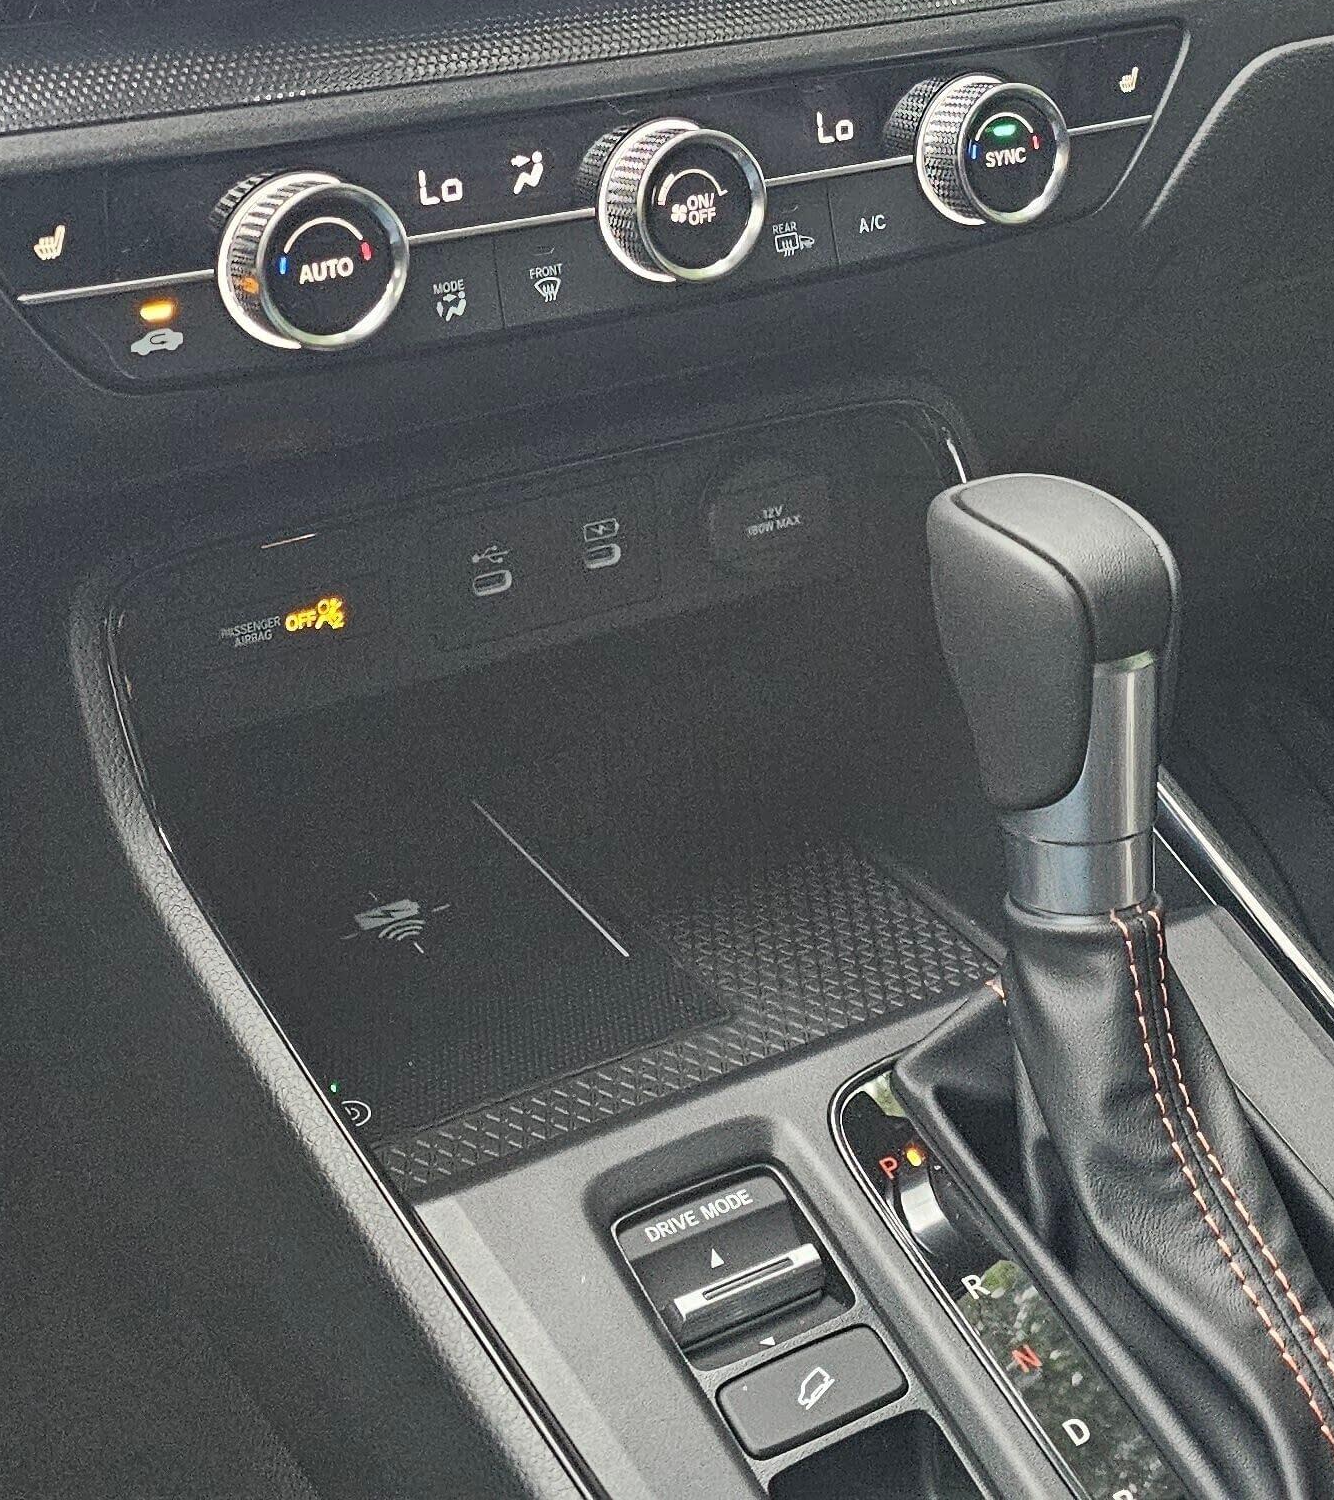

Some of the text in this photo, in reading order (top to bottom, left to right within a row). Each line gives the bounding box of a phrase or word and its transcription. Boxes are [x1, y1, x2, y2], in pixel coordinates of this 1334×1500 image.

[985, 146, 1027, 169] SYNC
[686, 192, 715, 211] ON/
[688, 207, 716, 227] OFF
[772, 221, 797, 235] REAR
[859, 214, 886, 235] A/C
[298, 256, 354, 286] AUTO
[529, 263, 563, 280] FRONT
[433, 278, 465, 296] MODE
[762, 503, 784, 519] 12V
[776, 514, 801, 530] MAX
[220, 615, 281, 639] PASSENGER
[285, 609, 317, 632] OFF
[234, 628, 273, 648] AIRBAG
[879, 1155, 898, 1180] P
[644, 1188, 754, 1243] DRIVE MODE
[961, 1274, 991, 1300] R
[1011, 1343, 1043, 1373] N
[1061, 1417, 1091, 1447] D
